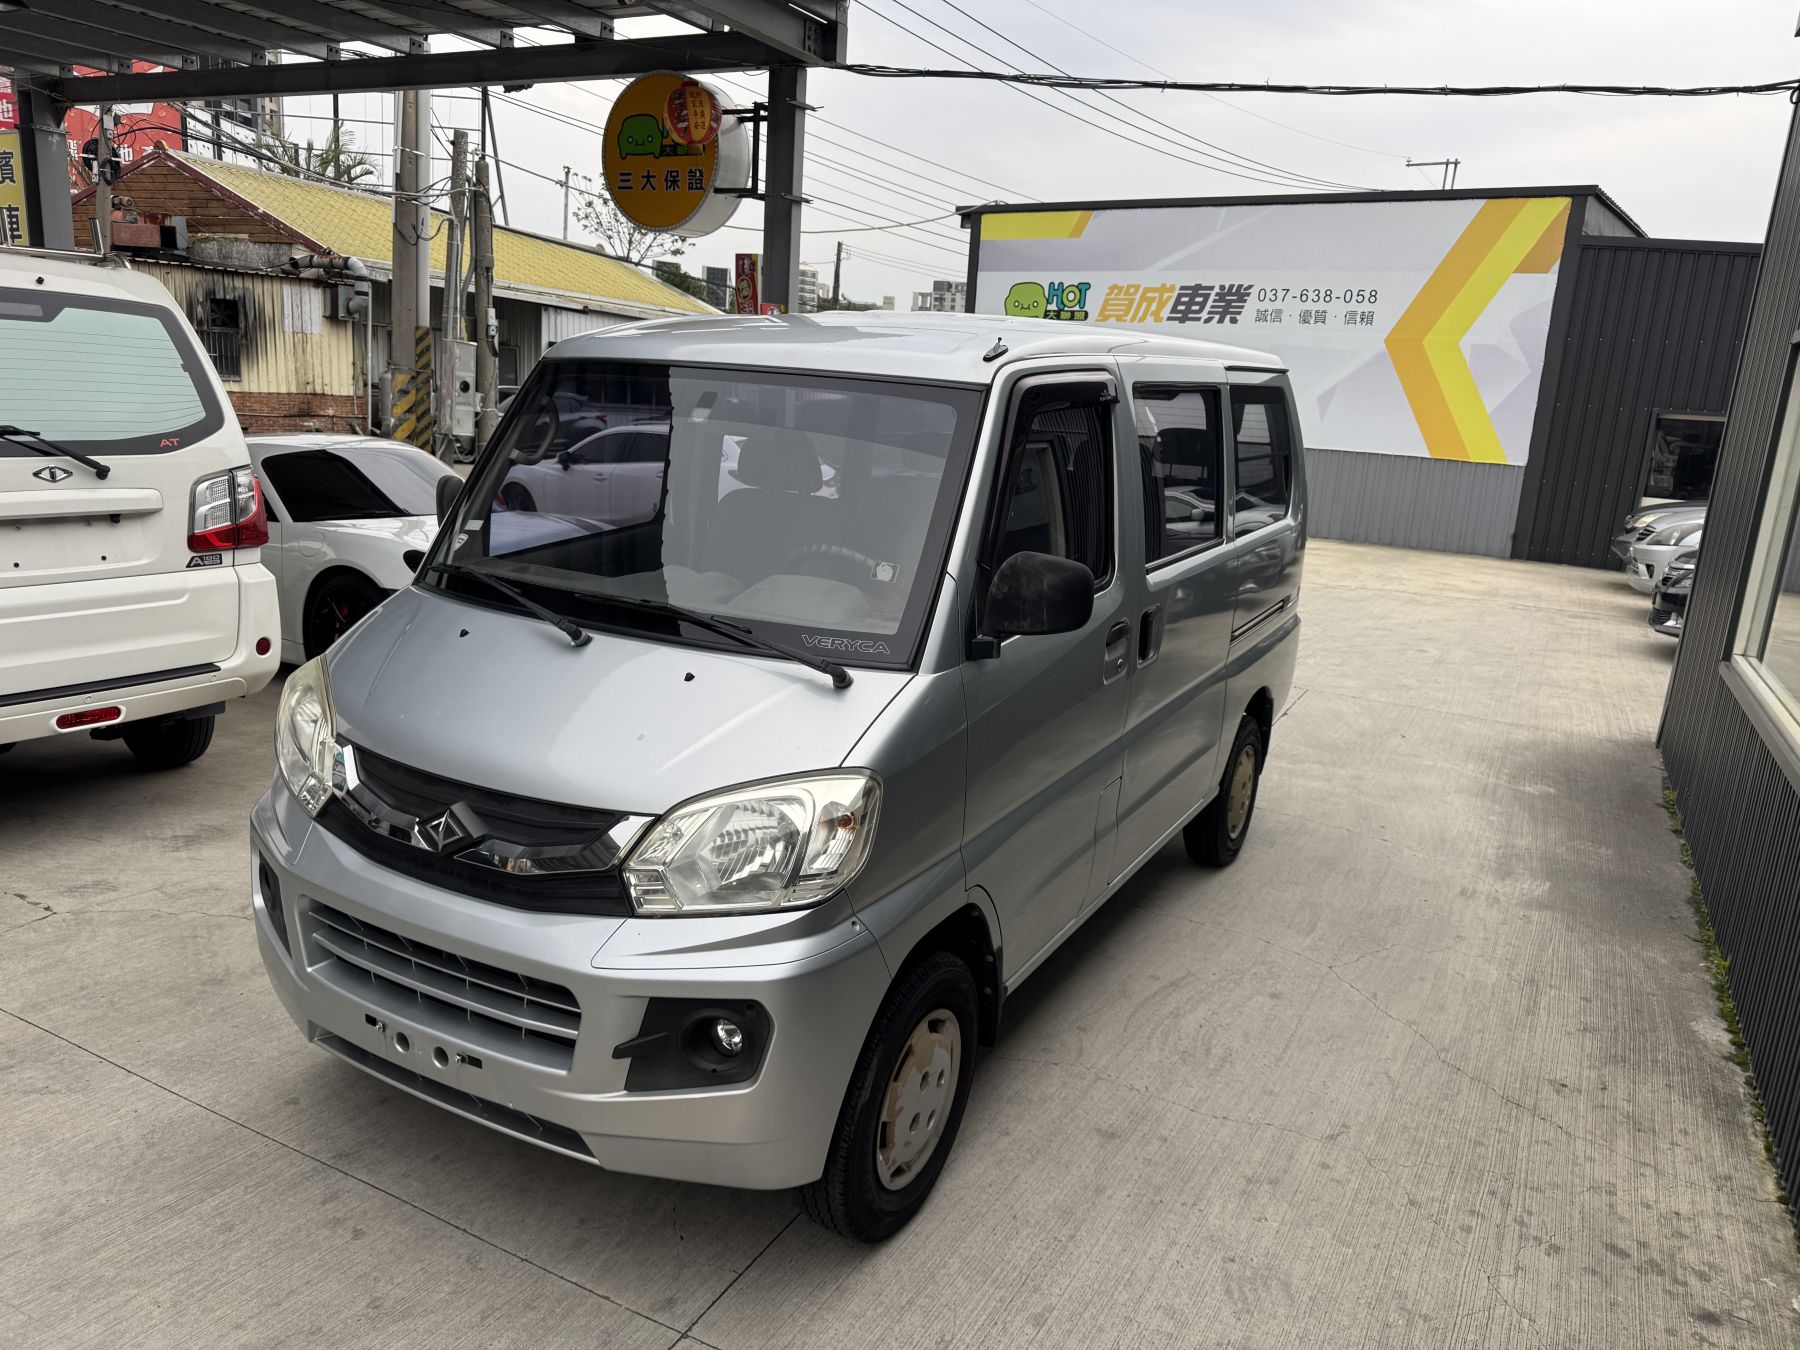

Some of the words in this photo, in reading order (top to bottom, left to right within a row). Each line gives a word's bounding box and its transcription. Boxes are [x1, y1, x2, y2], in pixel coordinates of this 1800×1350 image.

[617, 168, 705, 191] 三大保證
[1048, 282, 1091, 310] HOT
[1095, 283, 1254, 324] 賀成車業
[1257, 288, 1378, 304] 037-638-058
[160, 438, 179, 447] AT
[802, 634, 890, 654] VERYCA
